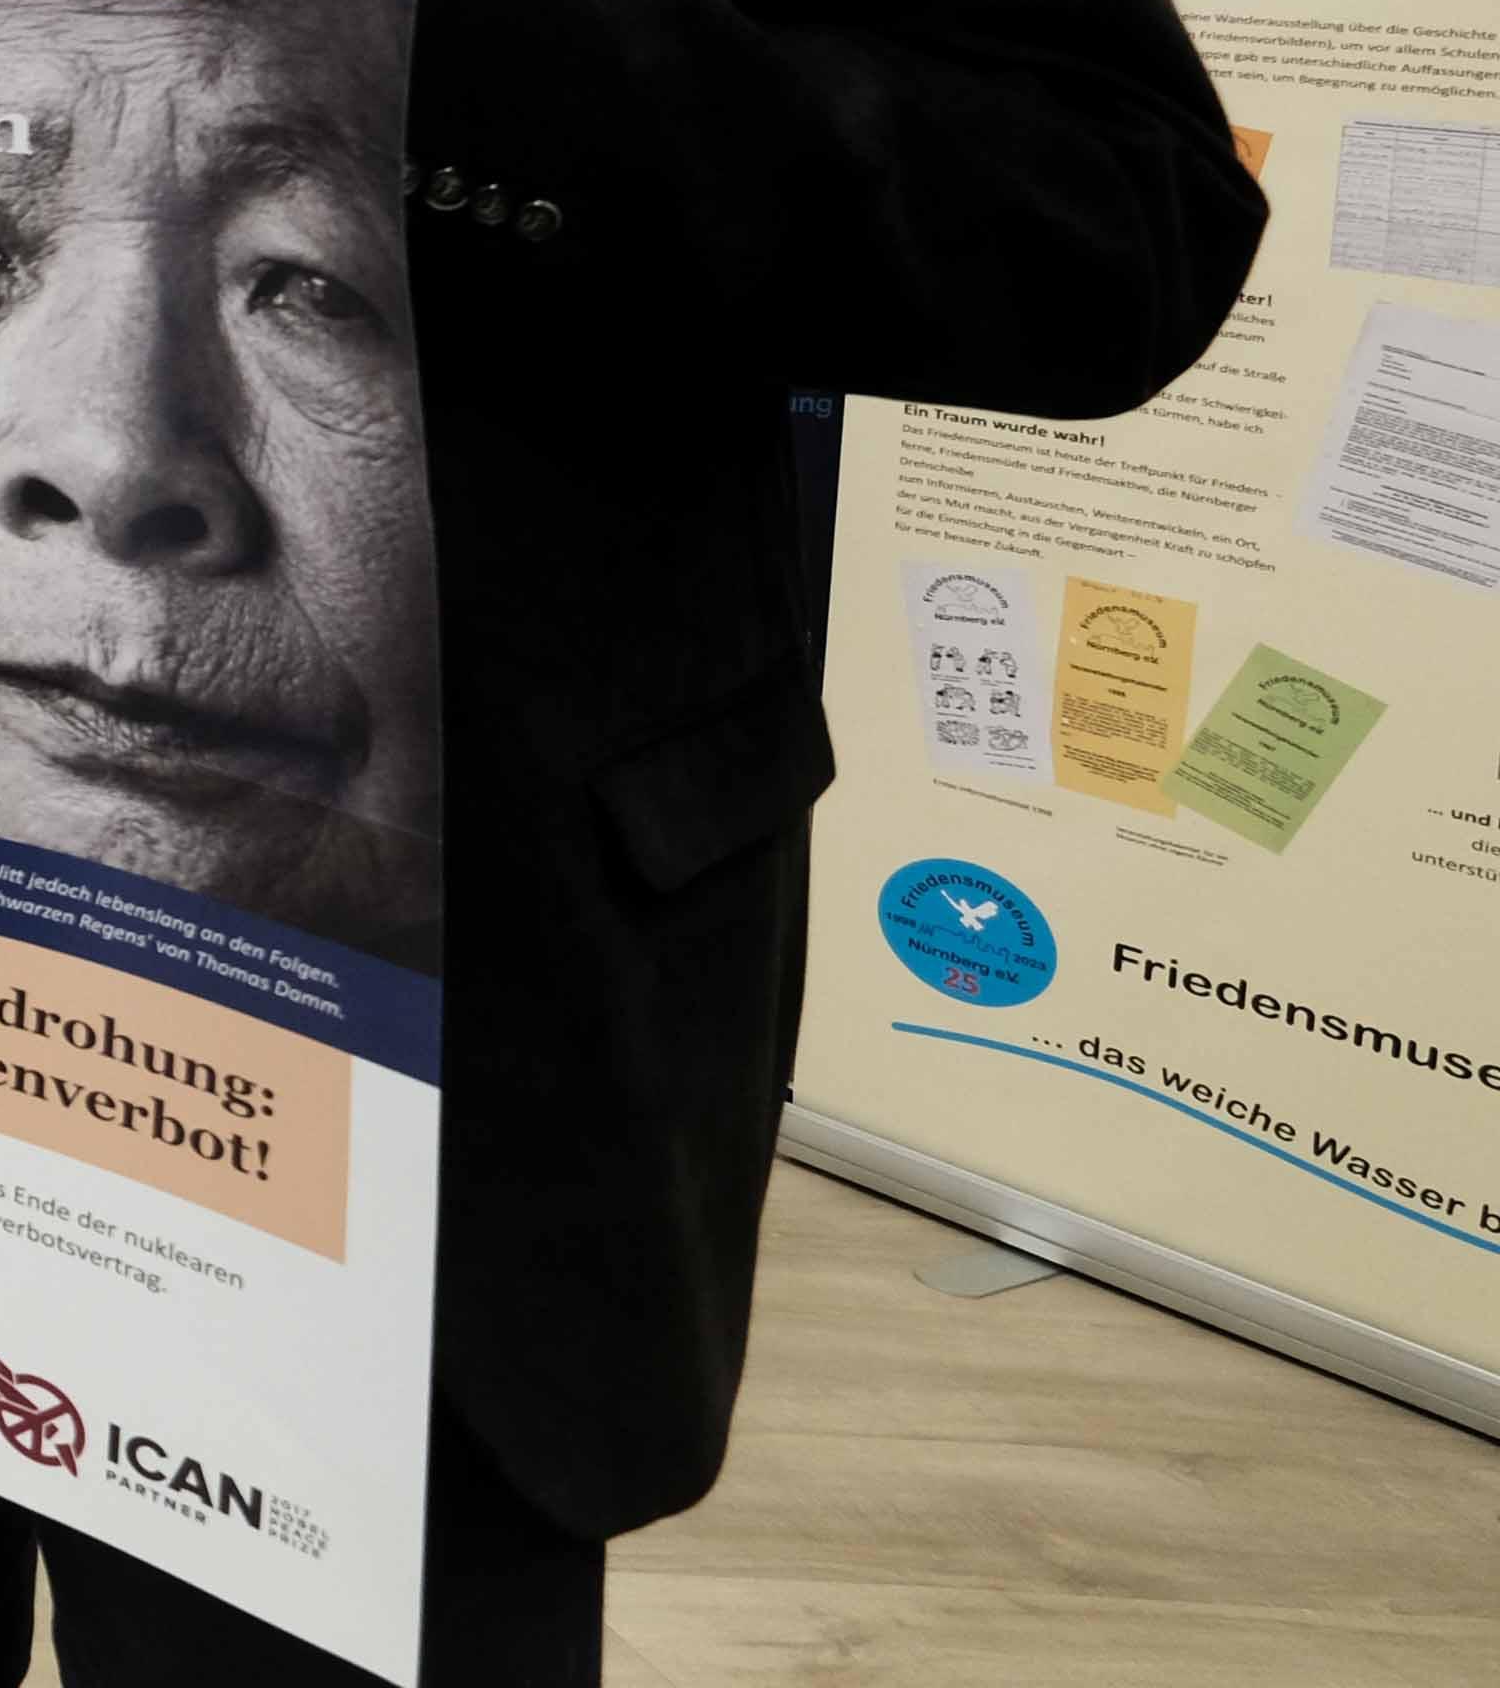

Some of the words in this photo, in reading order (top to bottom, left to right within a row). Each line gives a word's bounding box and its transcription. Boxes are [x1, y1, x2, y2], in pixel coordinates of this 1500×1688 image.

[903, 403, 930, 419] Ein
[934, 407, 989, 427] Traum
[993, 418, 1048, 439] wurde
[1053, 429, 1106, 447] wahr!
[1076, 1033, 1148, 1077] das
[1160, 1066, 1299, 1146] weiche
[1310, 1130, 1465, 1217] Wasser
[104, 1421, 265, 1533] ICAN
